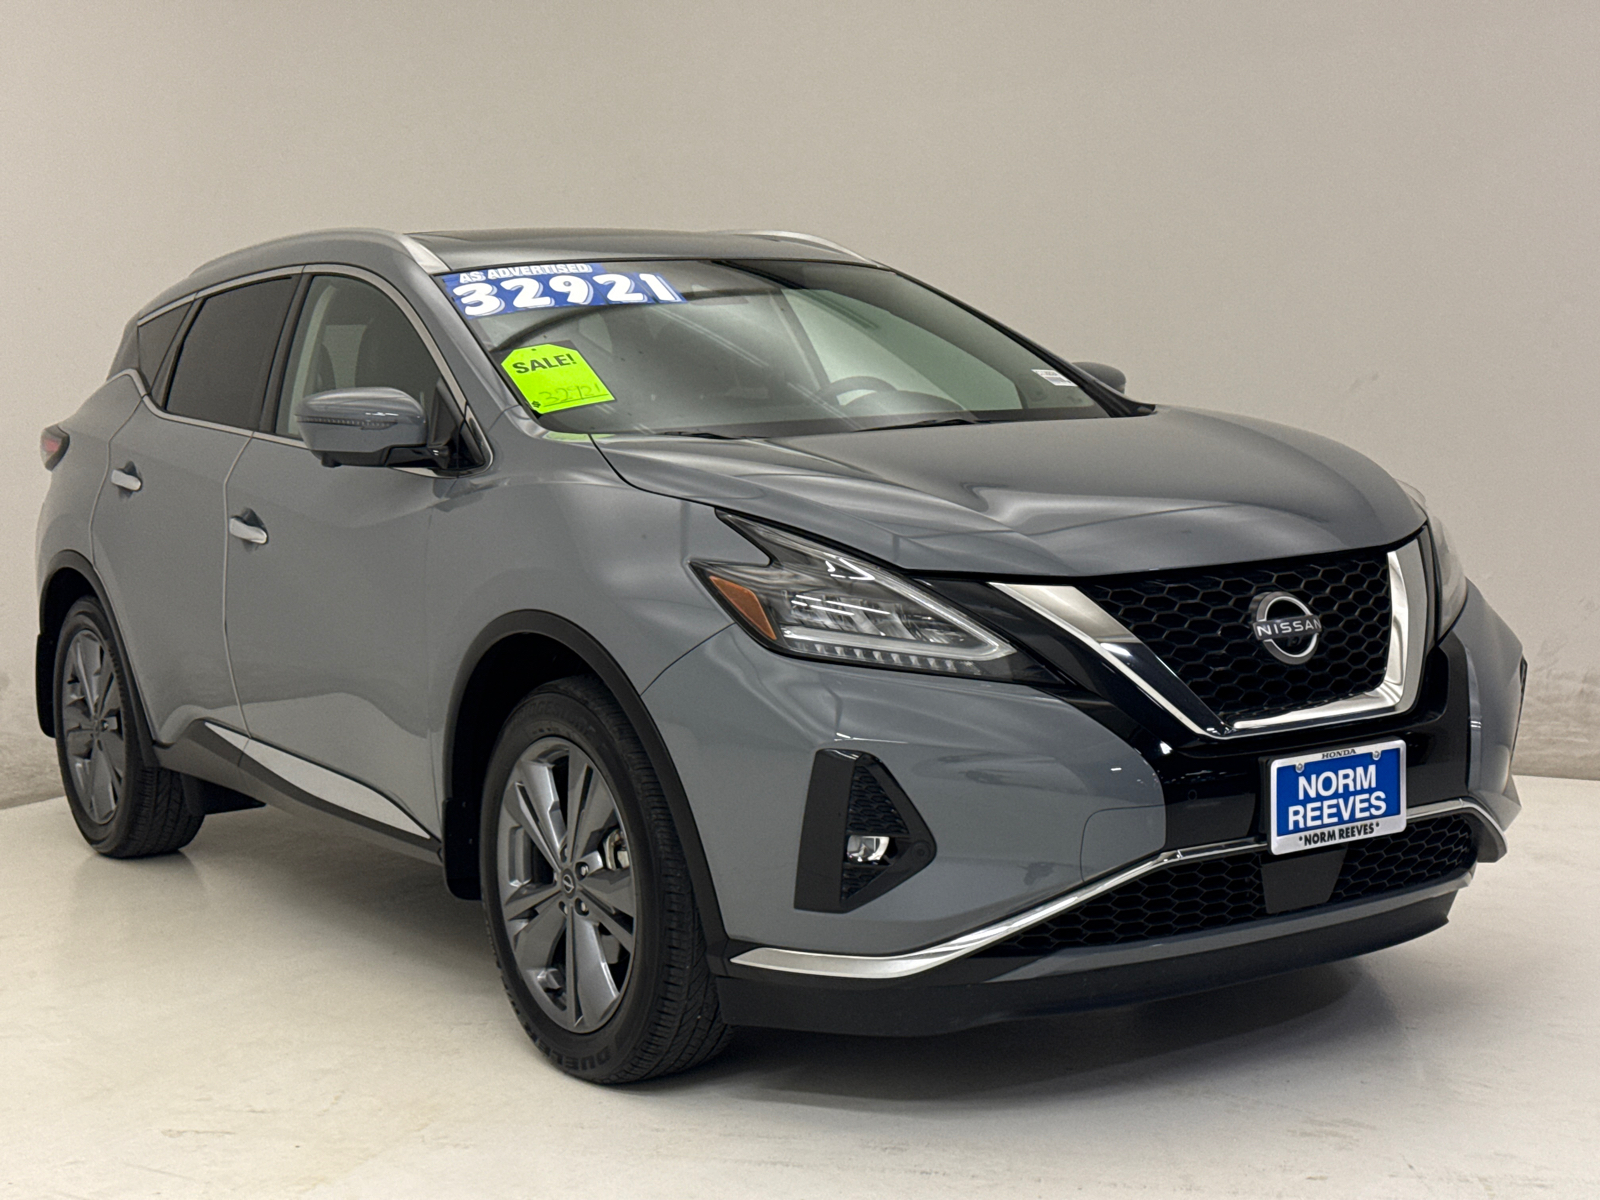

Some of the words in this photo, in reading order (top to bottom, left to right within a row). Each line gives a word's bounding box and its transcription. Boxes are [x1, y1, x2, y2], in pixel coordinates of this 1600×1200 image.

[459, 270, 486, 284] AS
[488, 263, 593, 280] ADVERTISED
[452, 273, 683, 317] 32921
[512, 353, 577, 374] SALE!
[1257, 614, 1322, 637] NISSAN
[1321, 748, 1357, 760] HONDA
[1298, 764, 1377, 800] NORM
[1288, 791, 1387, 831] REEVES
